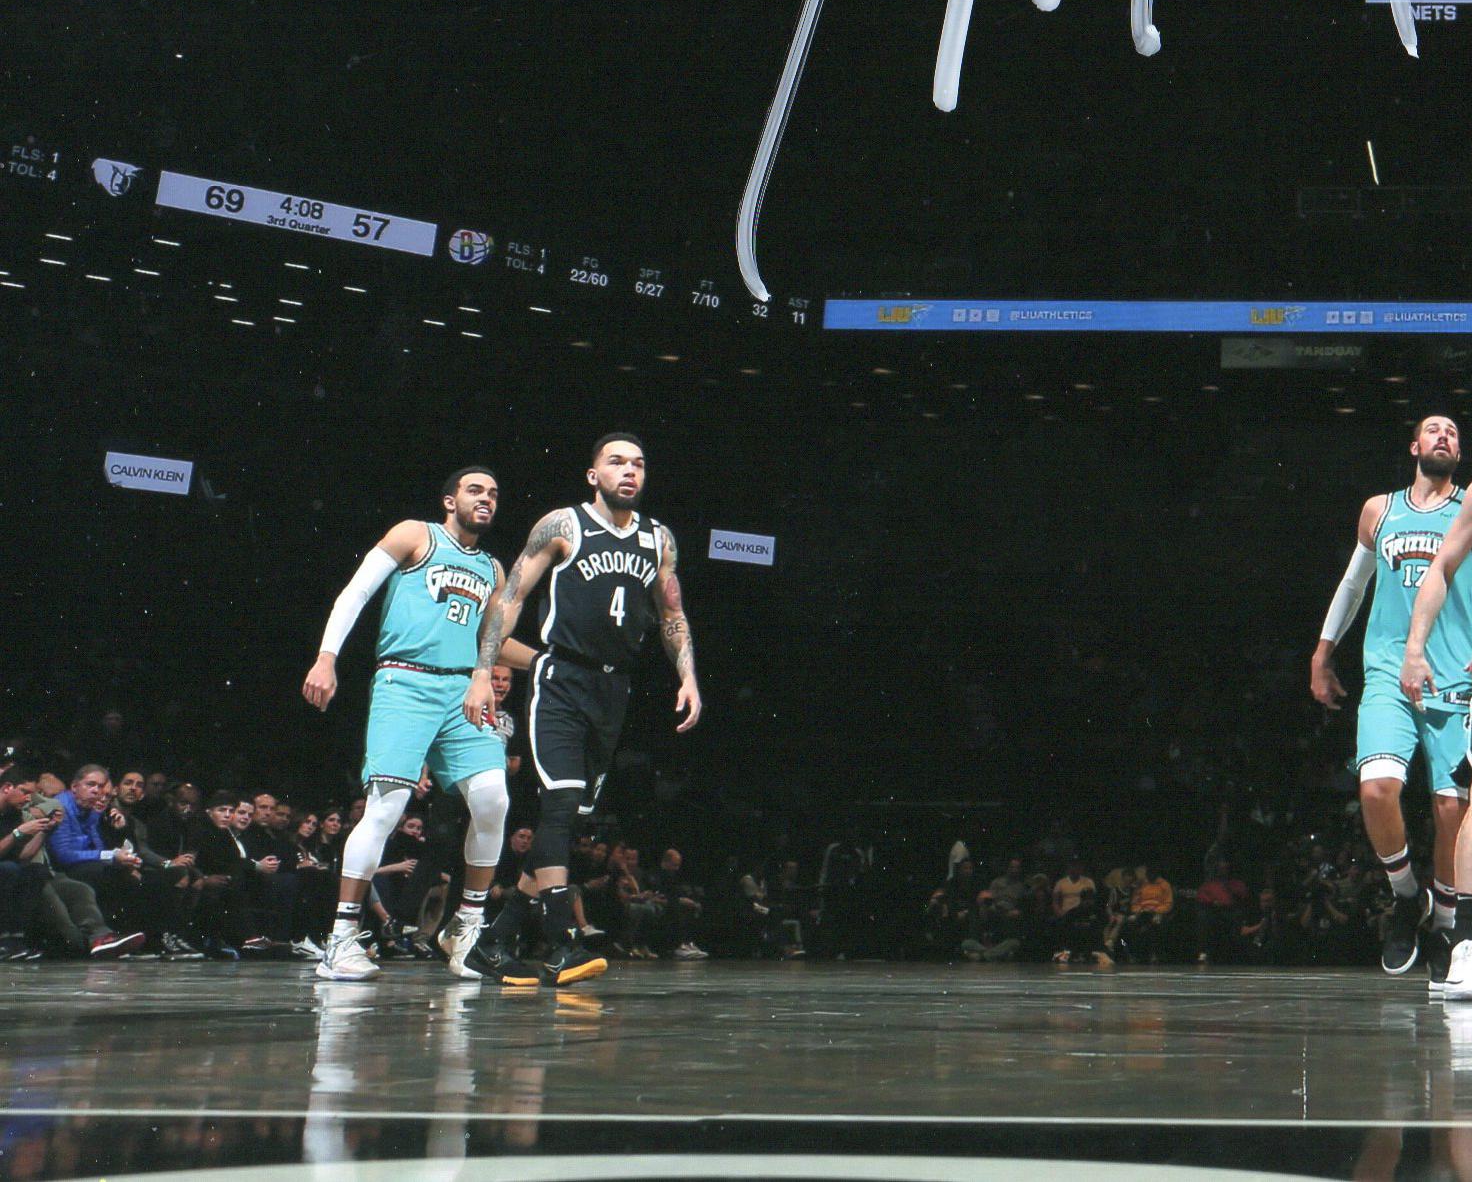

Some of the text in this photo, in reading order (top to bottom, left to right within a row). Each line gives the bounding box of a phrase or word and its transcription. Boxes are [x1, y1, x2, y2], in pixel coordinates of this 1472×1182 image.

[1411, 5, 1457, 21] NETS
[47, 169, 57, 181] 4
[205, 185, 245, 213] 69
[280, 197, 324, 220] 4:08
[267, 215, 331, 236] 3rd Quarter
[352, 213, 391, 241] 57
[570, 269, 609, 287] 22/60
[635, 281, 665, 298] 6/27
[692, 291, 720, 308] 7/10
[752, 303, 769, 318] 32
[792, 311, 806, 325] 11
[111, 464, 185, 483] CALVIN KLEIN
[714, 539, 770, 555] CALVIN KLEIN
[577, 551, 658, 588] BROOKLYN
[447, 599, 471, 626] 21
[609, 586, 626, 626] 4
